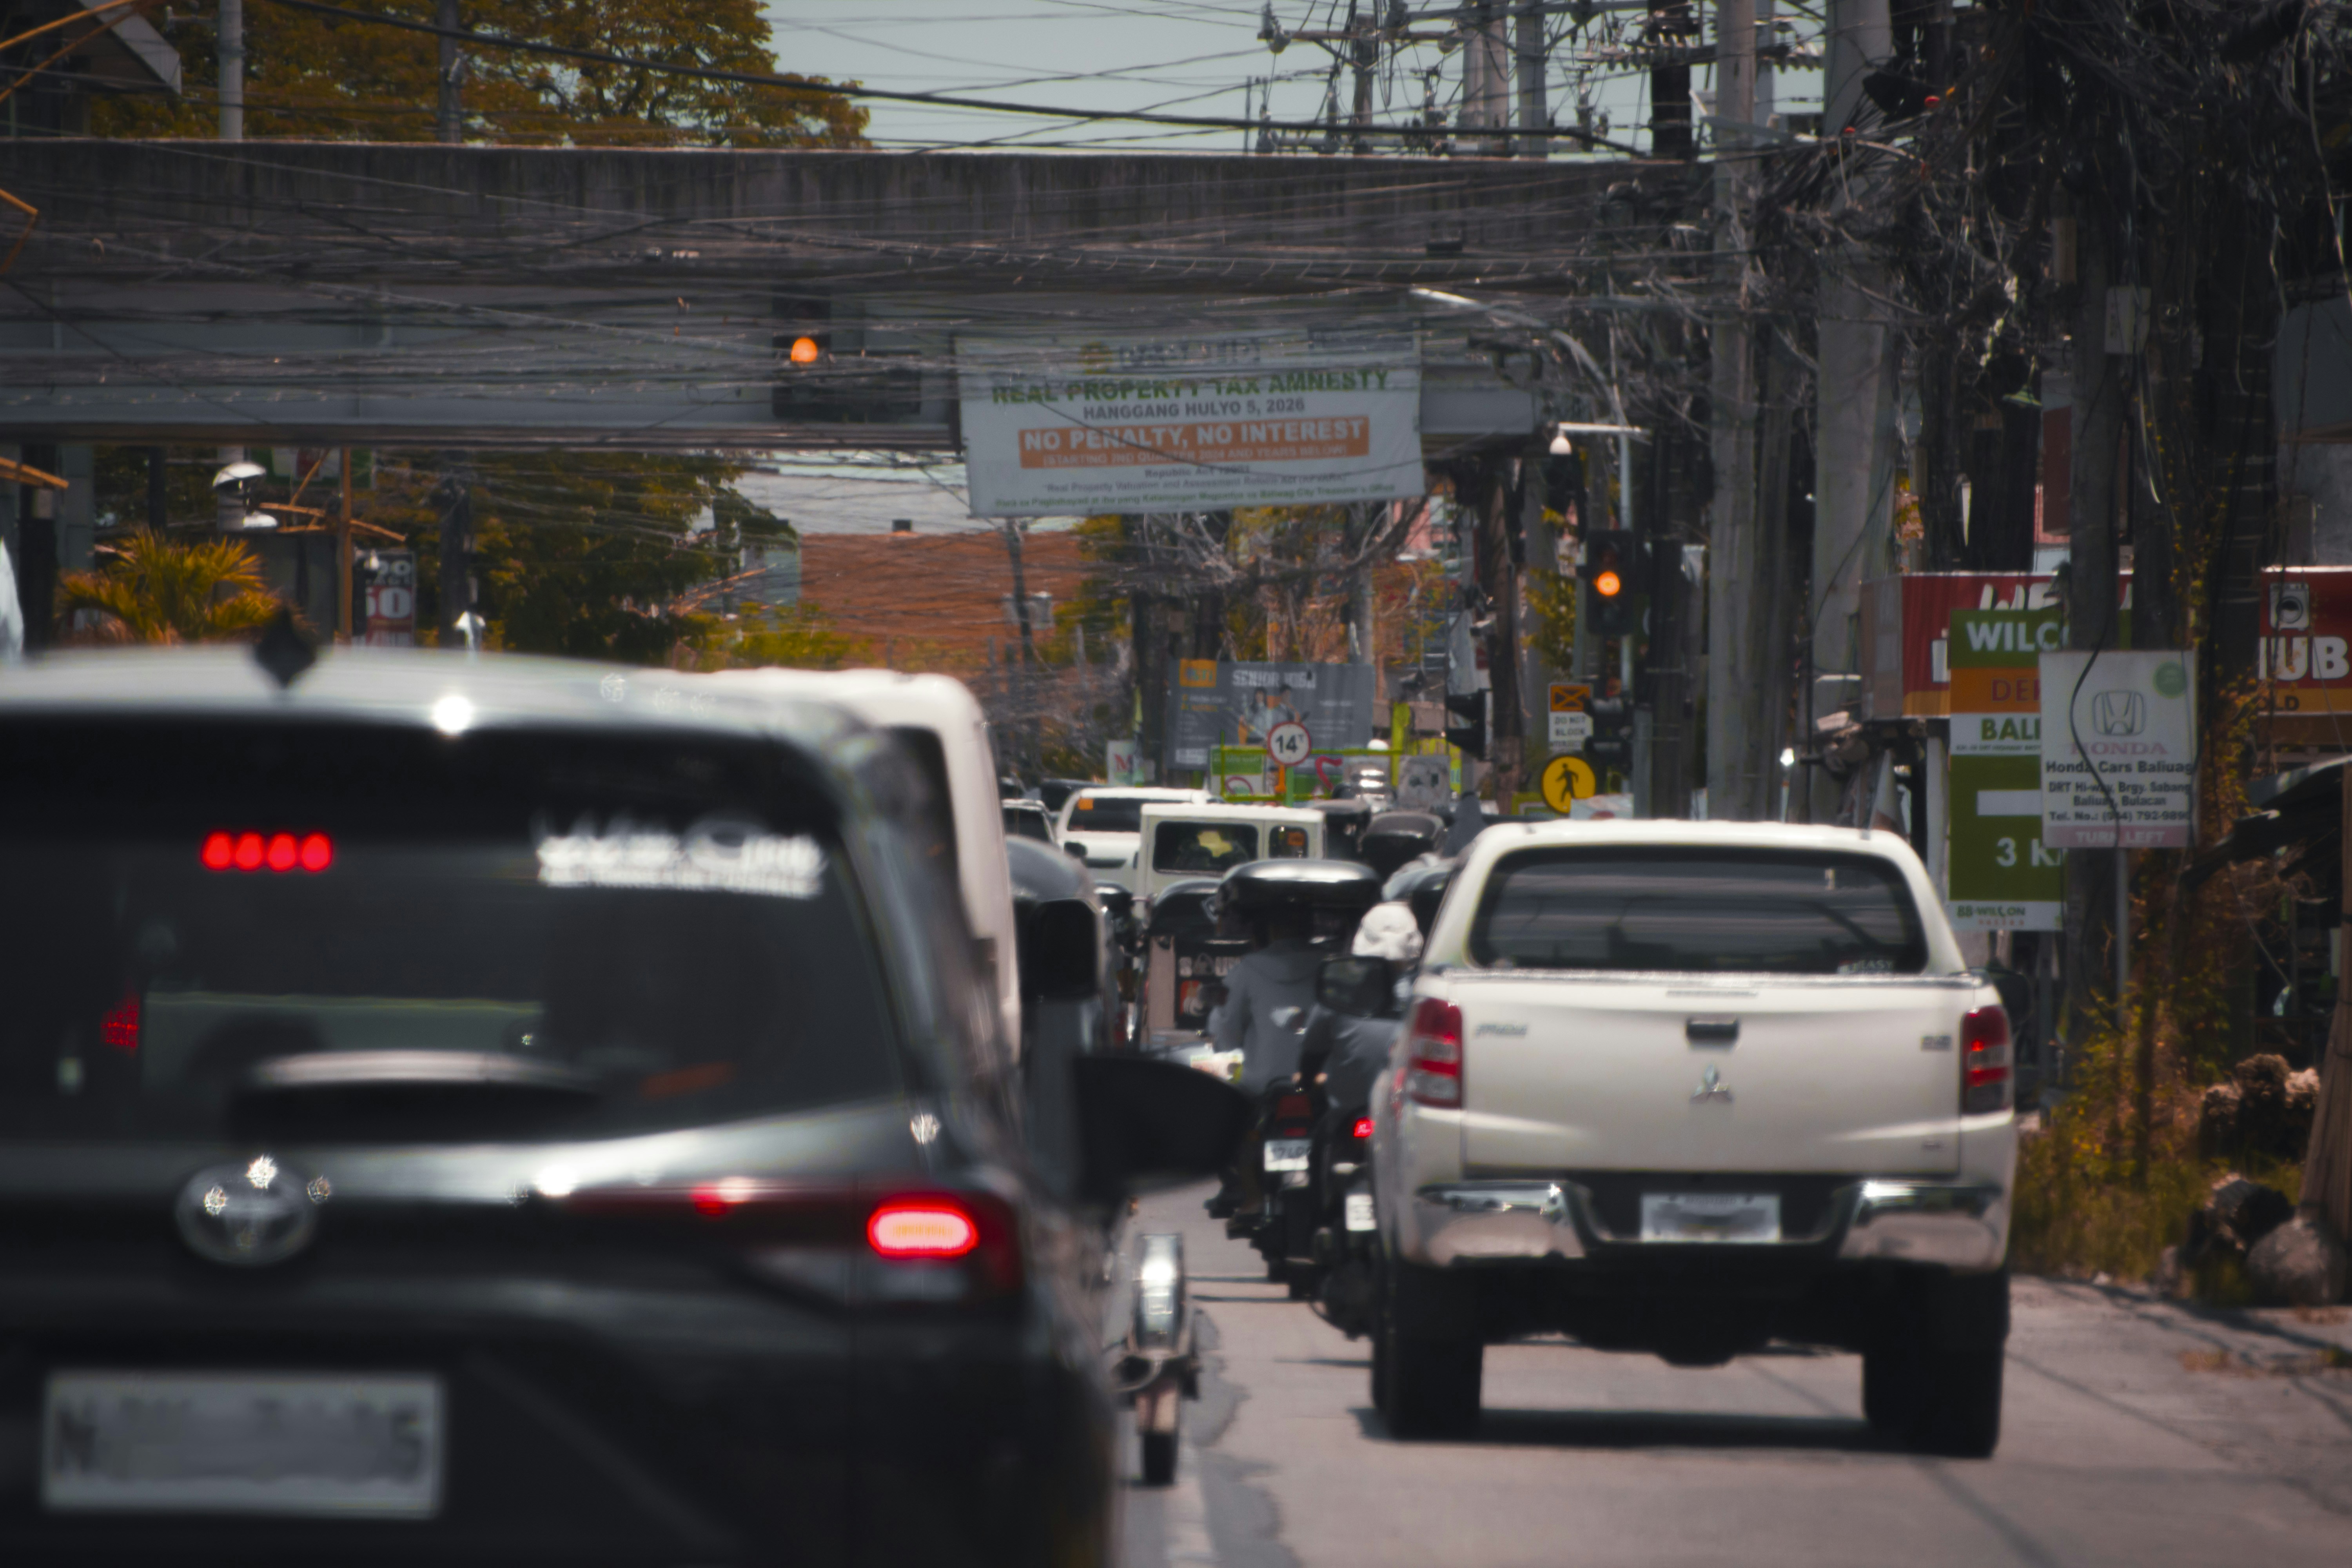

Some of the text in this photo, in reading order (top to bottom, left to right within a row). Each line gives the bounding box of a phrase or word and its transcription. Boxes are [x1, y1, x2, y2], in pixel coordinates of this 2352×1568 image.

[992, 383, 1058, 404] REAL
[1210, 375, 1259, 396] TAX
[1268, 369, 1388, 393] AMNESTY
[1083, 396, 1305, 421] HANGGANG HULYO 5, 2026
[1024, 418, 1363, 450] NO PENALTY, NO INTEREST
[1227, 448, 1253, 459] AND
[1257, 446, 1296, 458] YEARS
[2070, 742, 2168, 755] HONDA
[2046, 761, 2092, 775] Honda
[2098, 761, 2132, 775] Cars
[2049, 781, 2072, 793] DRT
[2122, 795, 2167, 806] Bulacan
[2049, 811, 2070, 820] Tel.
[2124, 831, 2165, 844] LEFT
[1995, 837, 2018, 868] 3
